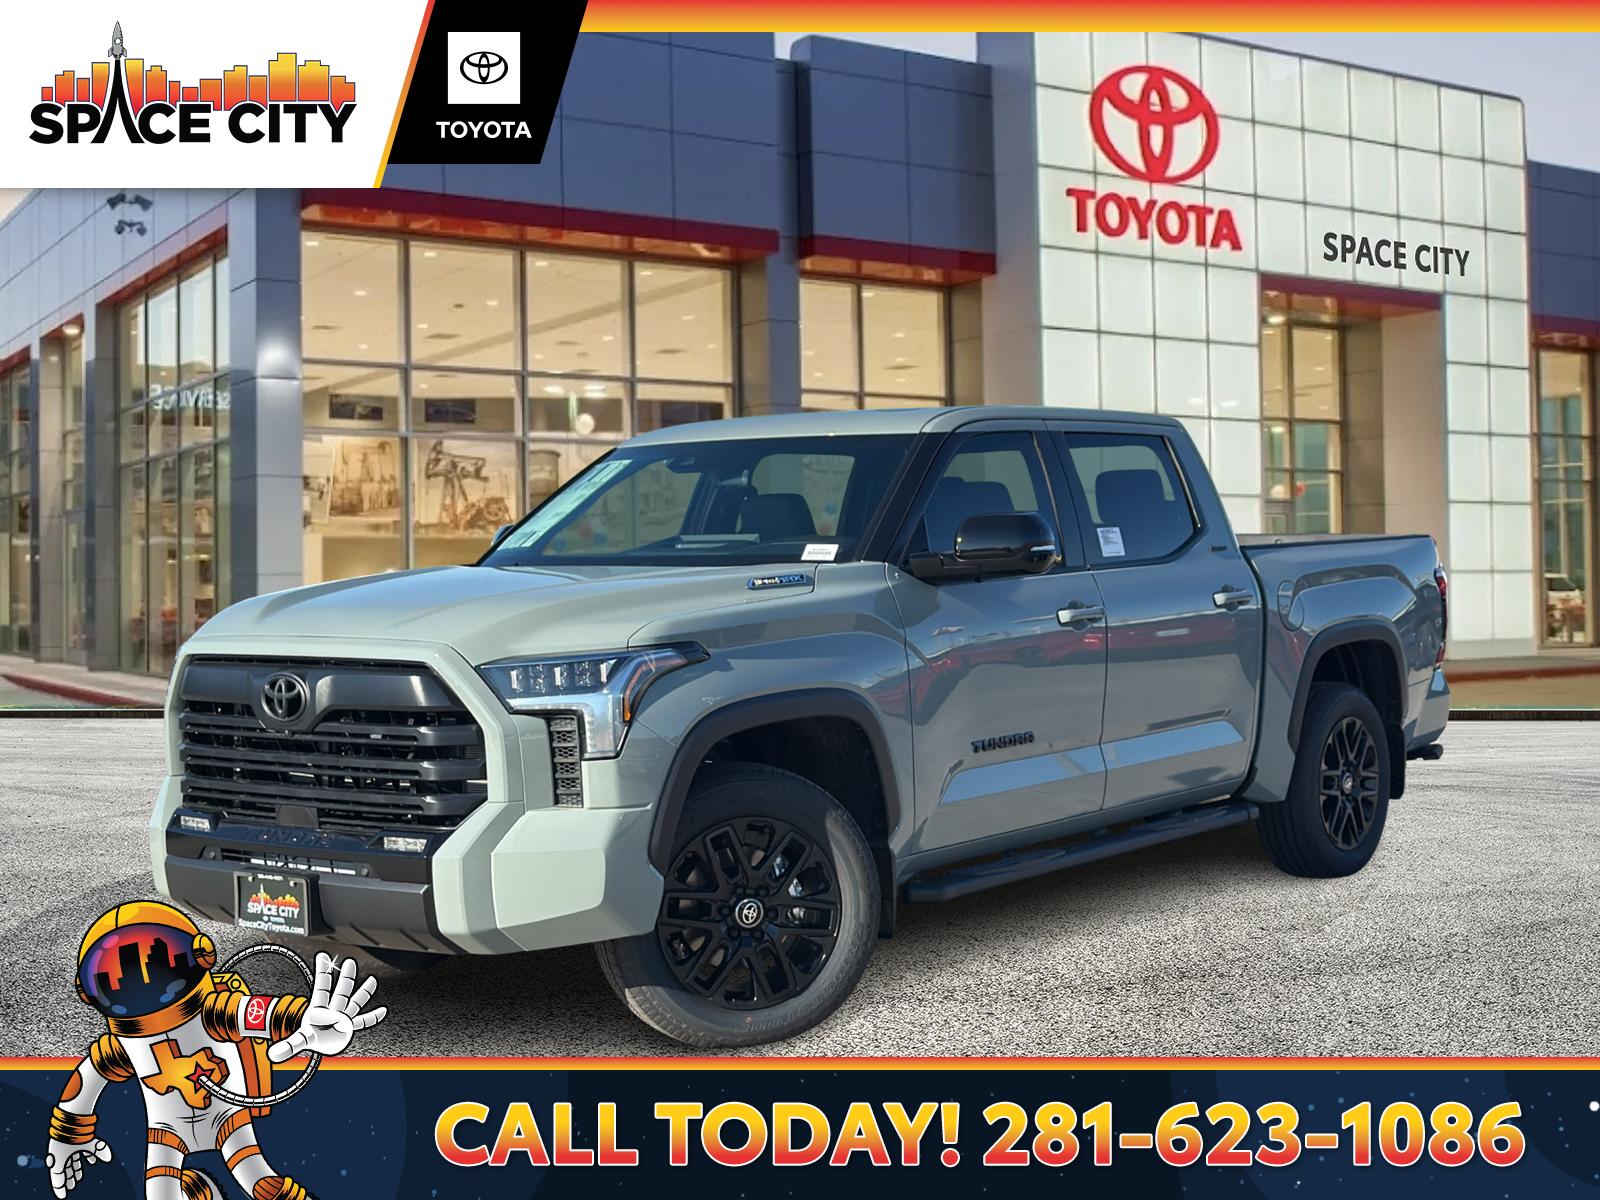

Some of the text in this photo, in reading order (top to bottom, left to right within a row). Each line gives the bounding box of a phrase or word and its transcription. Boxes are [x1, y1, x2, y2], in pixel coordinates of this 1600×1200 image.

[1066, 188, 1242, 251] TOYOTA
[1323, 232, 1470, 277] SPACE CITY
[970, 731, 1035, 753] TUNDRA
[247, 901, 300, 919] SPACE CITY
